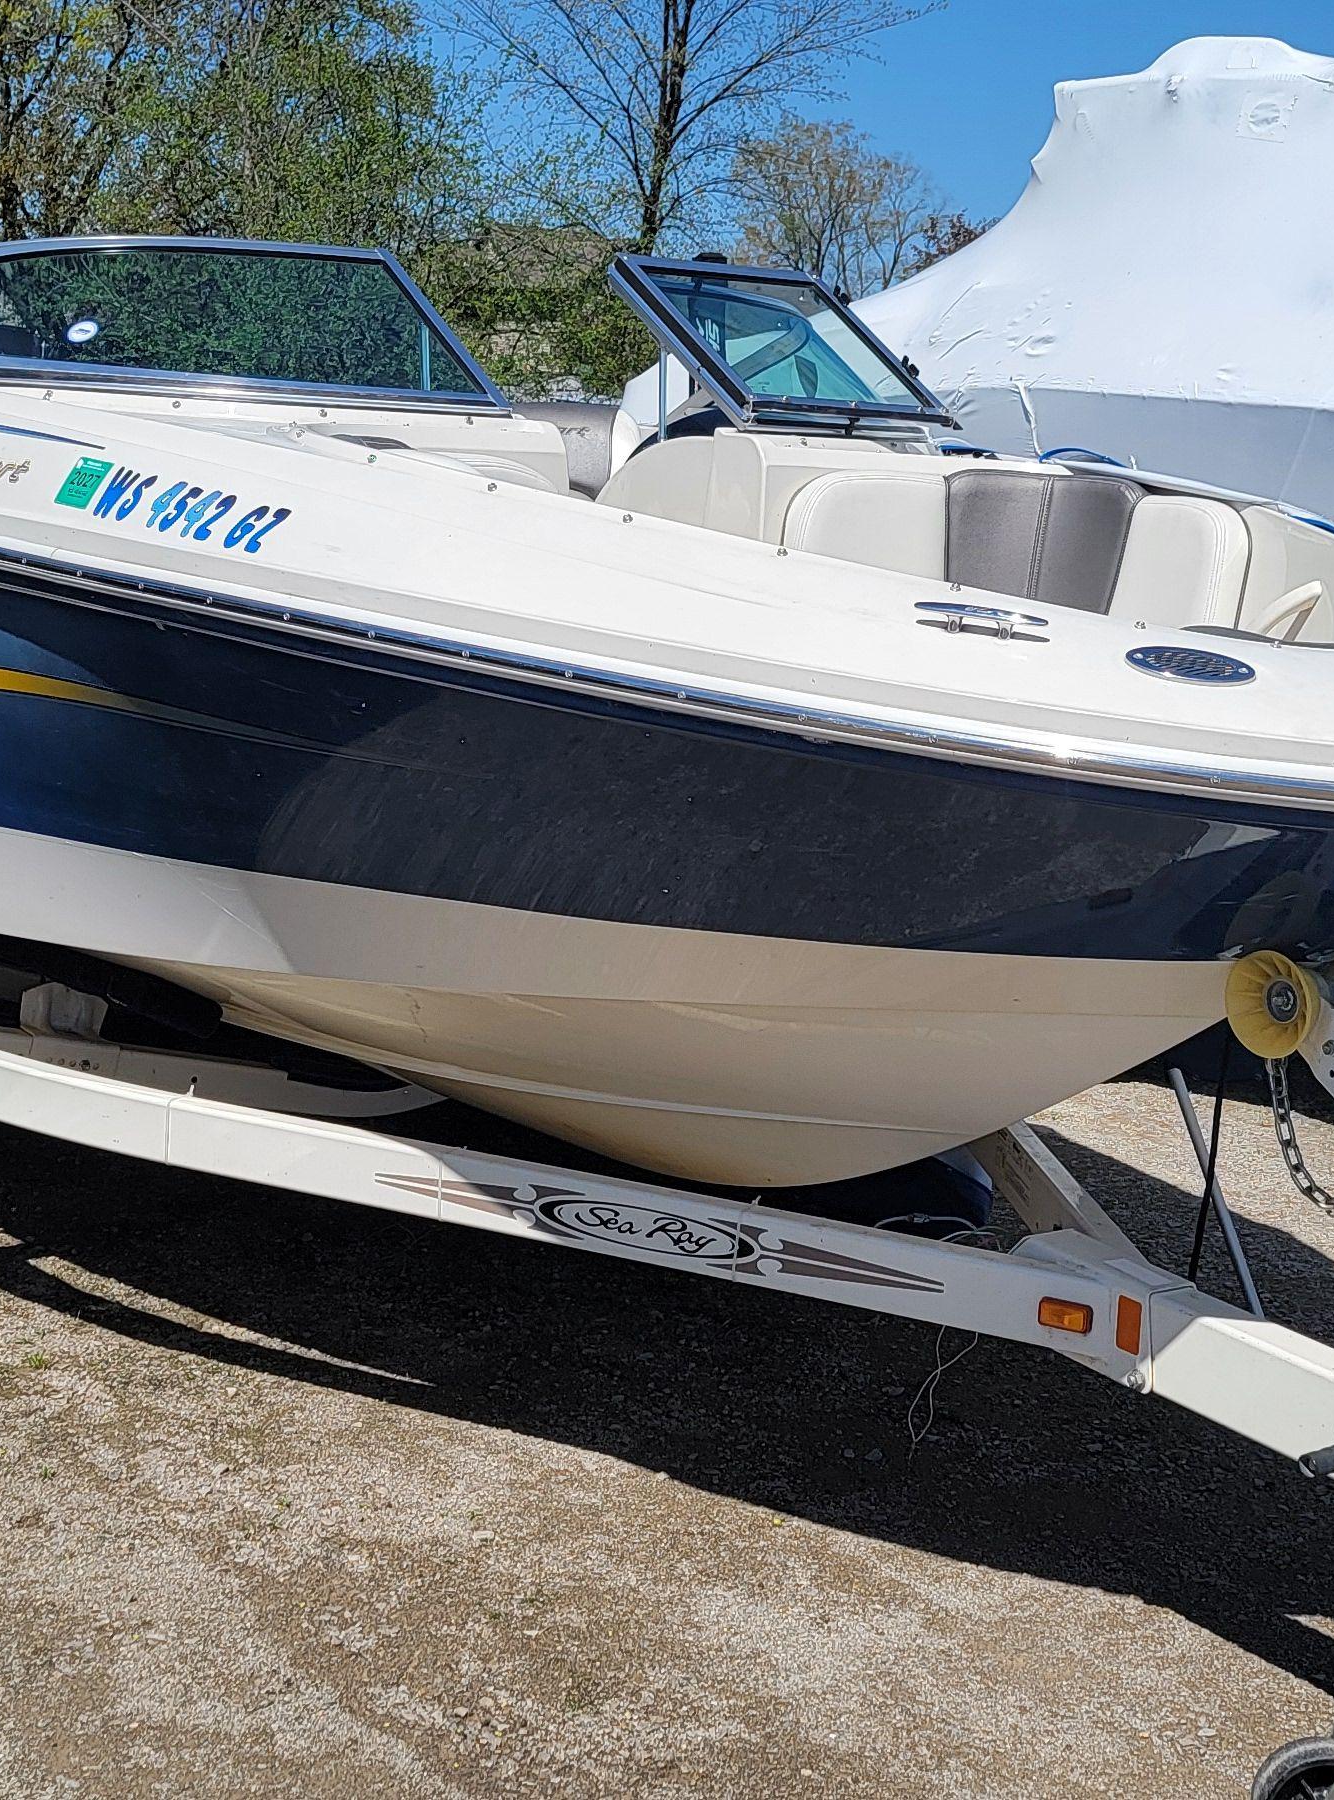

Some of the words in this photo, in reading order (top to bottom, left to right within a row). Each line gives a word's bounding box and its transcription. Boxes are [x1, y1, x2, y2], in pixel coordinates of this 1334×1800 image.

[69, 471, 101, 488] 2027
[93, 466, 158, 521] WS
[146, 481, 237, 541] 4542
[575, 1207, 642, 1235] Sea
[645, 1217, 718, 1254] Ray
